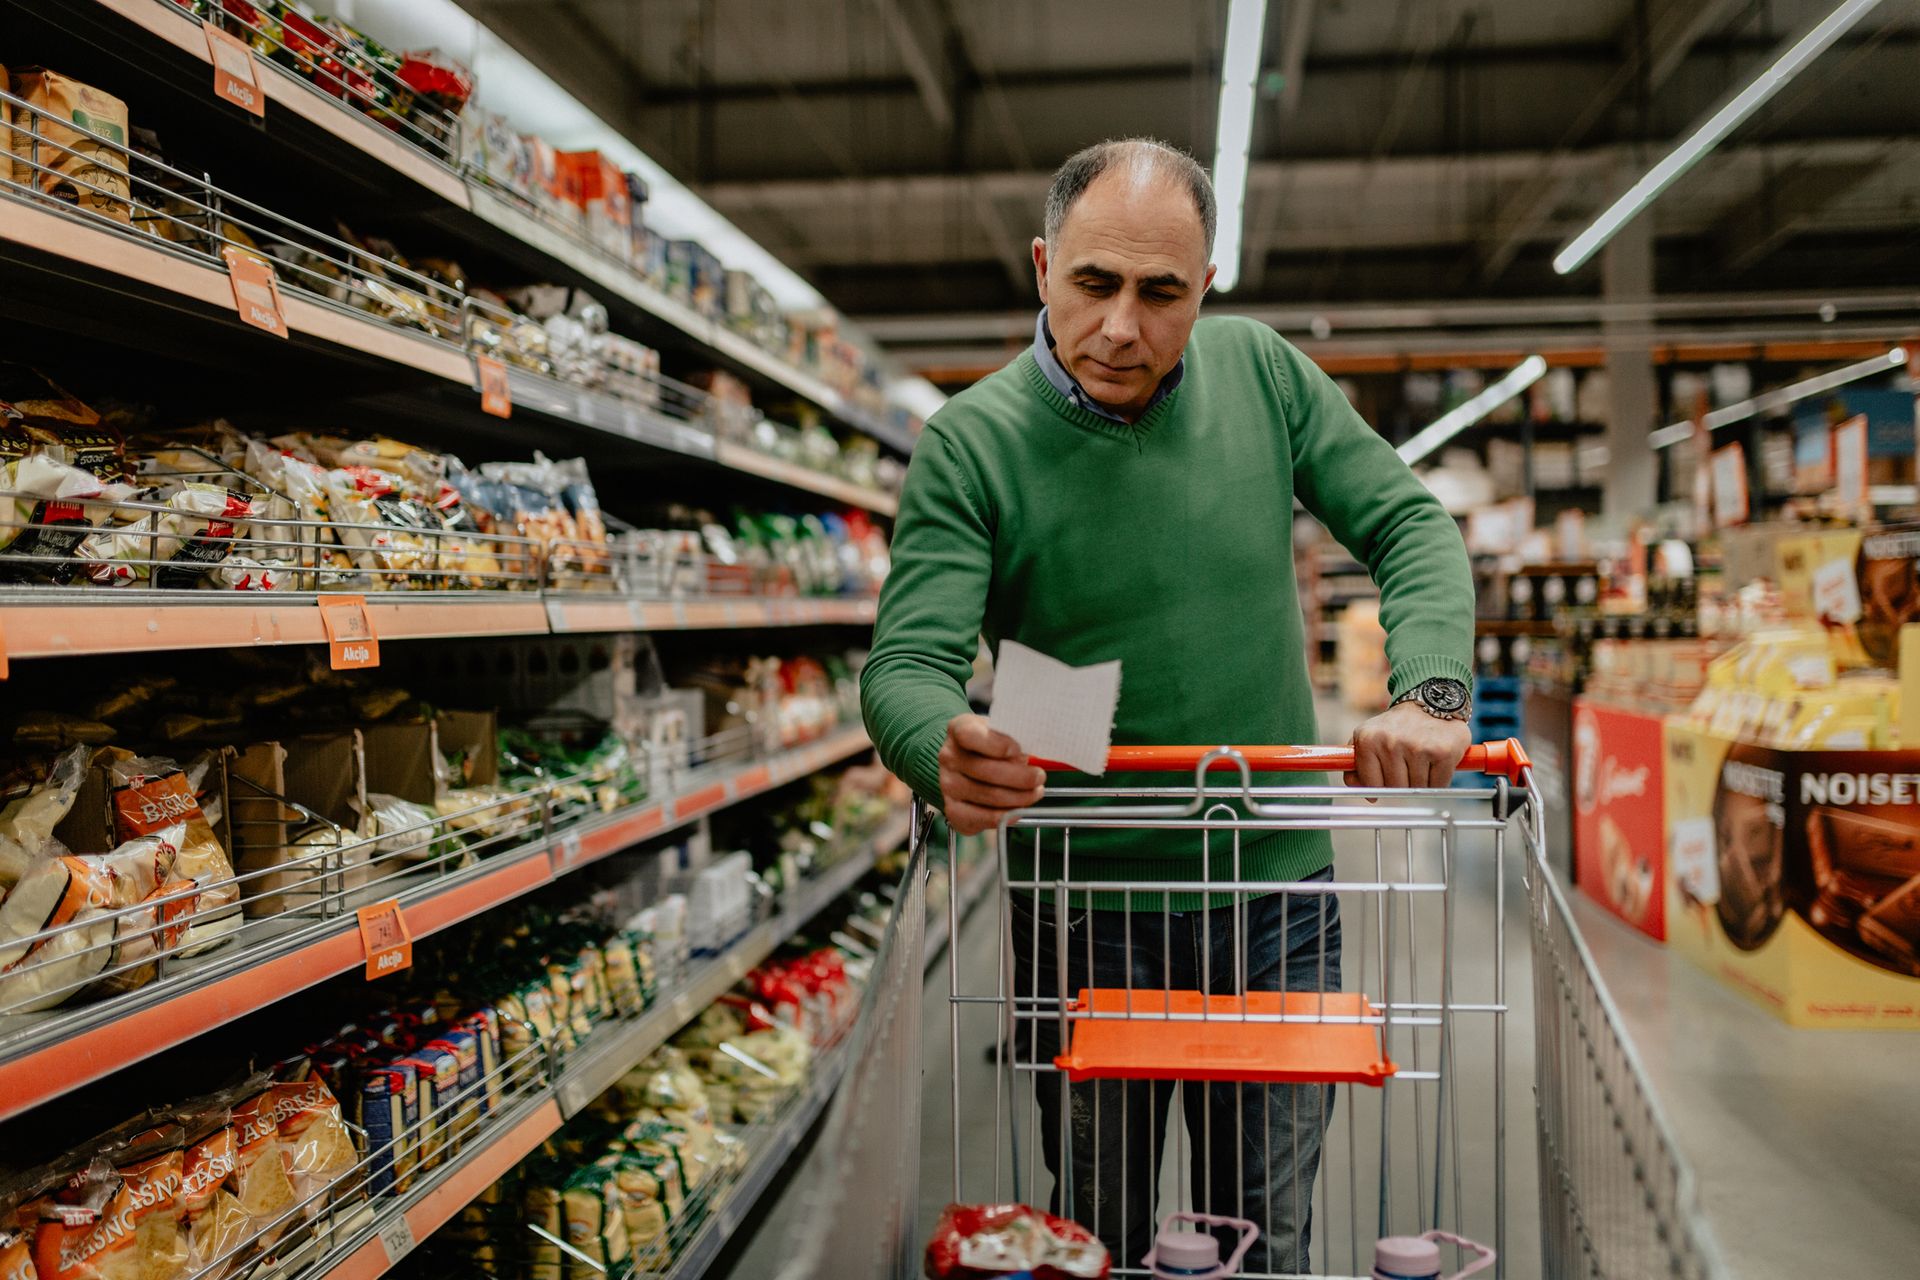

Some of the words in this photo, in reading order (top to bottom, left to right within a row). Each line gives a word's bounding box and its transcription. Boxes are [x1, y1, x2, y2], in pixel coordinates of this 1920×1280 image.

[226, 79, 255, 106] Akcija
[343, 646, 370, 664] Akcija
[377, 950, 404, 971] Akcija
